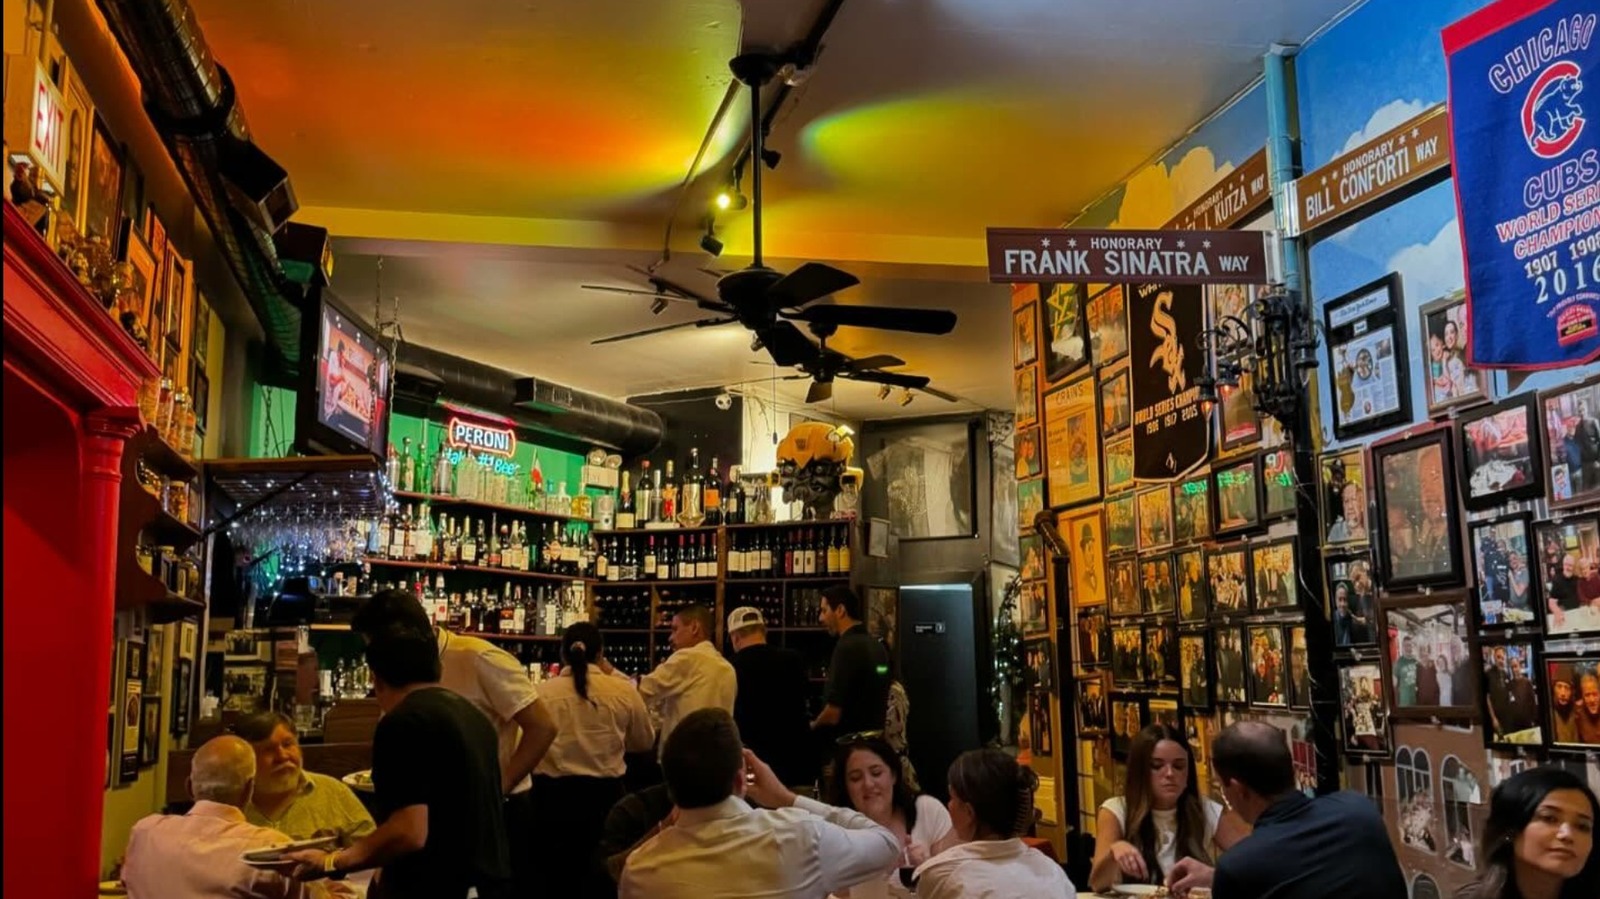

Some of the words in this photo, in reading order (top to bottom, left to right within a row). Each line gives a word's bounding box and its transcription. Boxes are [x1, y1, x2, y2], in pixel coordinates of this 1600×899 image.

[1488, 13, 1596, 94] CHICAGO
[35, 80, 64, 173] EXIT
[1305, 187, 1335, 222] BILL
[1339, 146, 1410, 204] CONFORTI
[1415, 136, 1438, 162] WAY
[1342, 138, 1395, 176] HONORARY
[1523, 149, 1599, 208] CUBS
[1214, 184, 1248, 226] KUTZA
[1250, 173, 1265, 196] WAY
[1495, 201, 1561, 243] WORLD
[1563, 180, 1600, 216] SERI
[1090, 238, 1163, 250] HONORARY
[1514, 206, 1600, 260] CHAMPION
[1004, 249, 1091, 275] FRANK
[1104, 250, 1210, 276] SINATRA
[1218, 255, 1249, 272] WAY
[1524, 250, 1558, 279] 1907
[1534, 254, 1600, 304] 2016
[455, 424, 510, 450] PERONI
[1181, 404, 1198, 421] 2005
[494, 457, 521, 475] Beer
